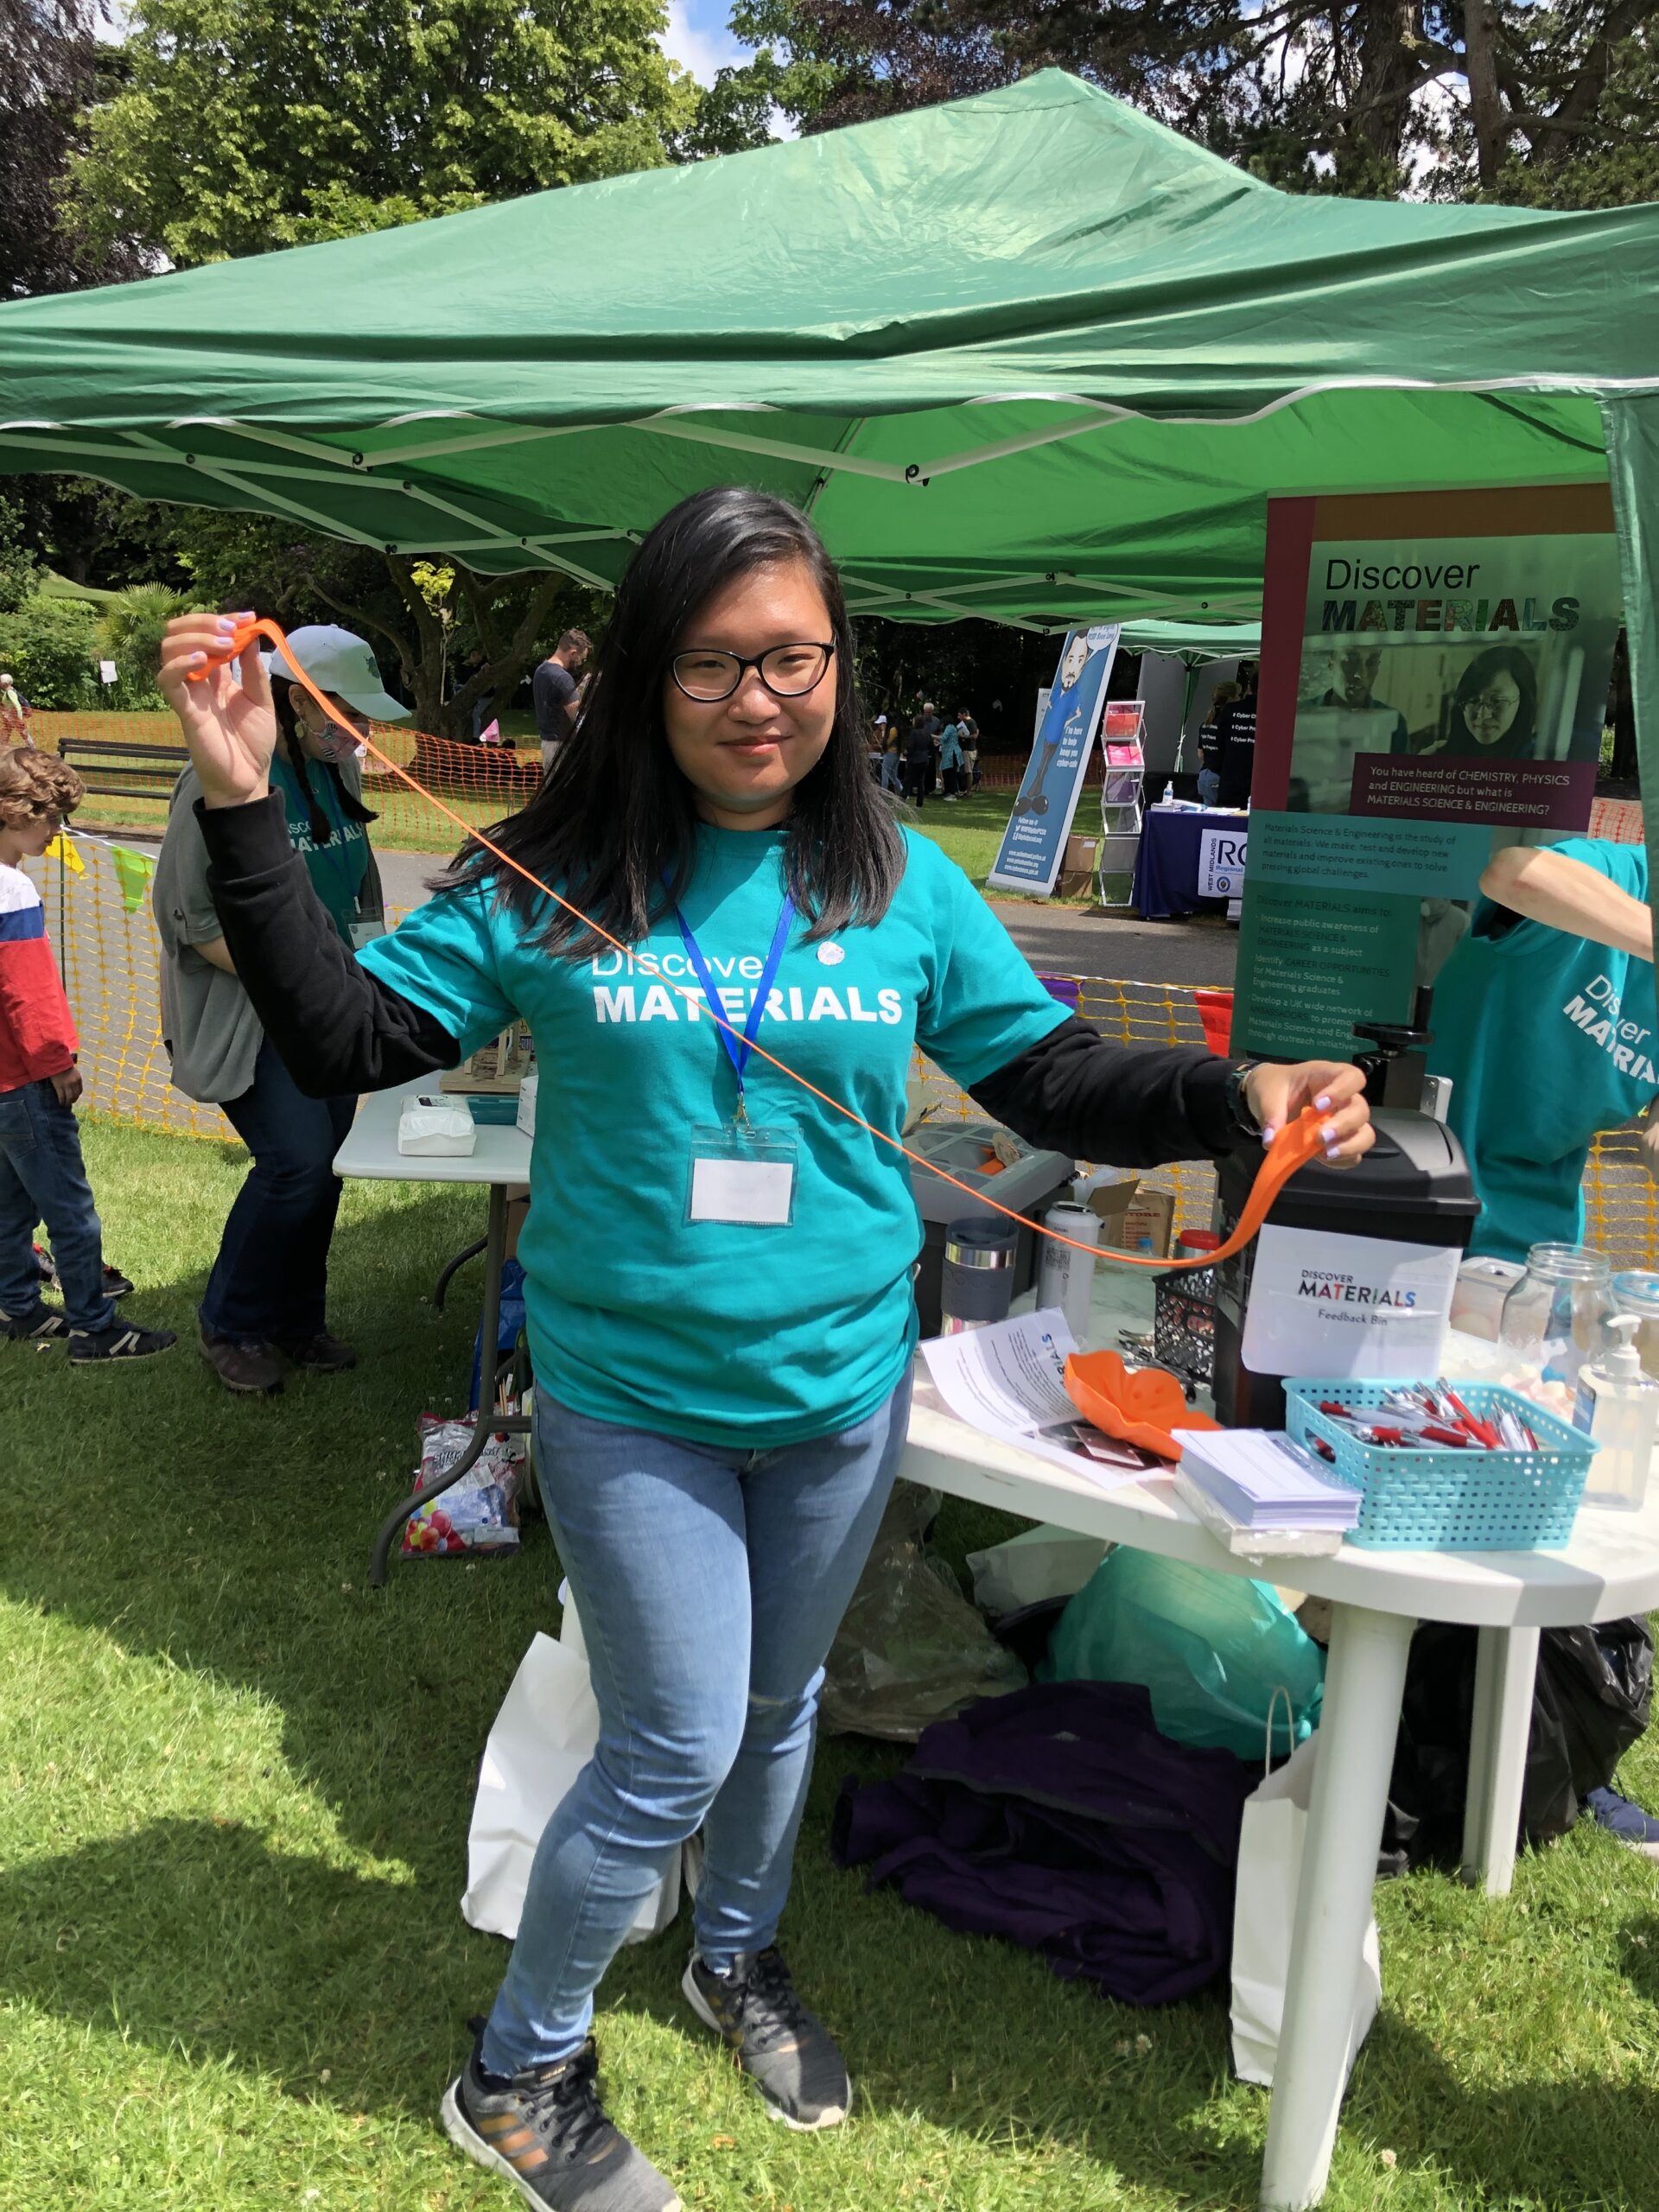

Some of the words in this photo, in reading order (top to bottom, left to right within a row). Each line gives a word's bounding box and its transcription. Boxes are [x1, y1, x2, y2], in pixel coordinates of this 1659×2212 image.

[1326, 559, 1480, 590] Discover
[1322, 597, 1580, 632] MATERIALS
[1370, 766, 1389, 776] You
[1392, 766, 1414, 778] have
[1416, 766, 1443, 779] heard
[1446, 768, 1457, 779] of
[1522, 774, 1570, 786] PHYSICS
[1369, 780, 1388, 791] and
[1390, 781, 1455, 795] ENGINEERING
[1457, 785, 1474, 795] but
[1477, 786, 1502, 797] what
[1504, 787, 1512, 798] is
[1367, 795, 1420, 807] MATERIALS
[1422, 798, 1463, 810] SCIENCE
[1465, 800, 1471, 810] &
[1475, 801, 1550, 816] ENGINEERING?
[1265, 823, 1298, 834] Materials
[1300, 825, 1333, 836] Science
[1344, 829, 1394, 842] Engineering
[1405, 833, 1418, 842] the
[1420, 835, 1442, 845] study
[1446, 836, 1455, 845] of
[1315, 840, 1329, 849] We
[1360, 842, 1376, 852] test
[1378, 844, 1394, 854] and
[1396, 846, 1429, 858] develop
[1432, 849, 1448, 858] new
[1262, 849, 1297, 860] materials
[1299, 851, 1315, 861] and
[1317, 854, 1353, 866] improve
[1356, 855, 1390, 868] existing
[1391, 860, 1411, 869] ones
[1414, 861, 1422, 869] to
[1425, 862, 1448, 872] solve
[1262, 862, 1293, 874] pressing
[1294, 863, 1319, 875] global
[1256, 894, 1293, 907] Discover
[1295, 899, 1350, 912] MATERIALS
[1352, 905, 1376, 915] aims
[1259, 925, 1300, 938] MATERIALS
[1301, 930, 1339, 942] SCIENCE
[1340, 934, 1347, 943] &
[1260, 913, 1292, 925] Increase
[1293, 918, 1320, 929] public
[1321, 921, 1368, 932] awareness
[1370, 925, 1380, 934] of
[1257, 937, 1310, 951] ENGINEERING
[1331, 946, 1363, 957] subject
[591, 945, 769, 979] Discove
[1255, 954, 1284, 966] Identify
[1285, 957, 1318, 969] CAREER
[1319, 961, 1390, 977] OPPORTUNITIES
[1254, 966, 1264, 975] for
[1265, 967, 1301, 980] Materials
[1303, 971, 1336, 983] Science
[1337, 976, 1344, 984] &
[1253, 977, 1296, 993] Engineering
[1298, 984, 1341, 995] graduates
[593, 985, 902, 1025] MATERIALS
[1251, 994, 1281, 1006] Develop
[1290, 998, 1303, 1007] UK
[1304, 1001, 1325, 1011] wide
[1326, 1005, 1363, 1015] network
[1363, 1007, 1373, 1017] of
[1249, 1017, 1282, 1029] Materials
[1283, 1021, 1315, 1034] Science
[1317, 1026, 1333, 1036] and
[1335, 1027, 1354, 1040] Eng
[1311, 1014, 1319, 1022] to
[1248, 1028, 1276, 1041] through
[1278, 1033, 1314, 1046] outreach
[1316, 1039, 1359, 1052] initiatives
[1300, 1269, 1354, 1284] DISCOVER
[1298, 1280, 1417, 1308] MATERIALS
[1318, 1308, 1367, 1325] Feedback
[1370, 1314, 1388, 1326] Bin
